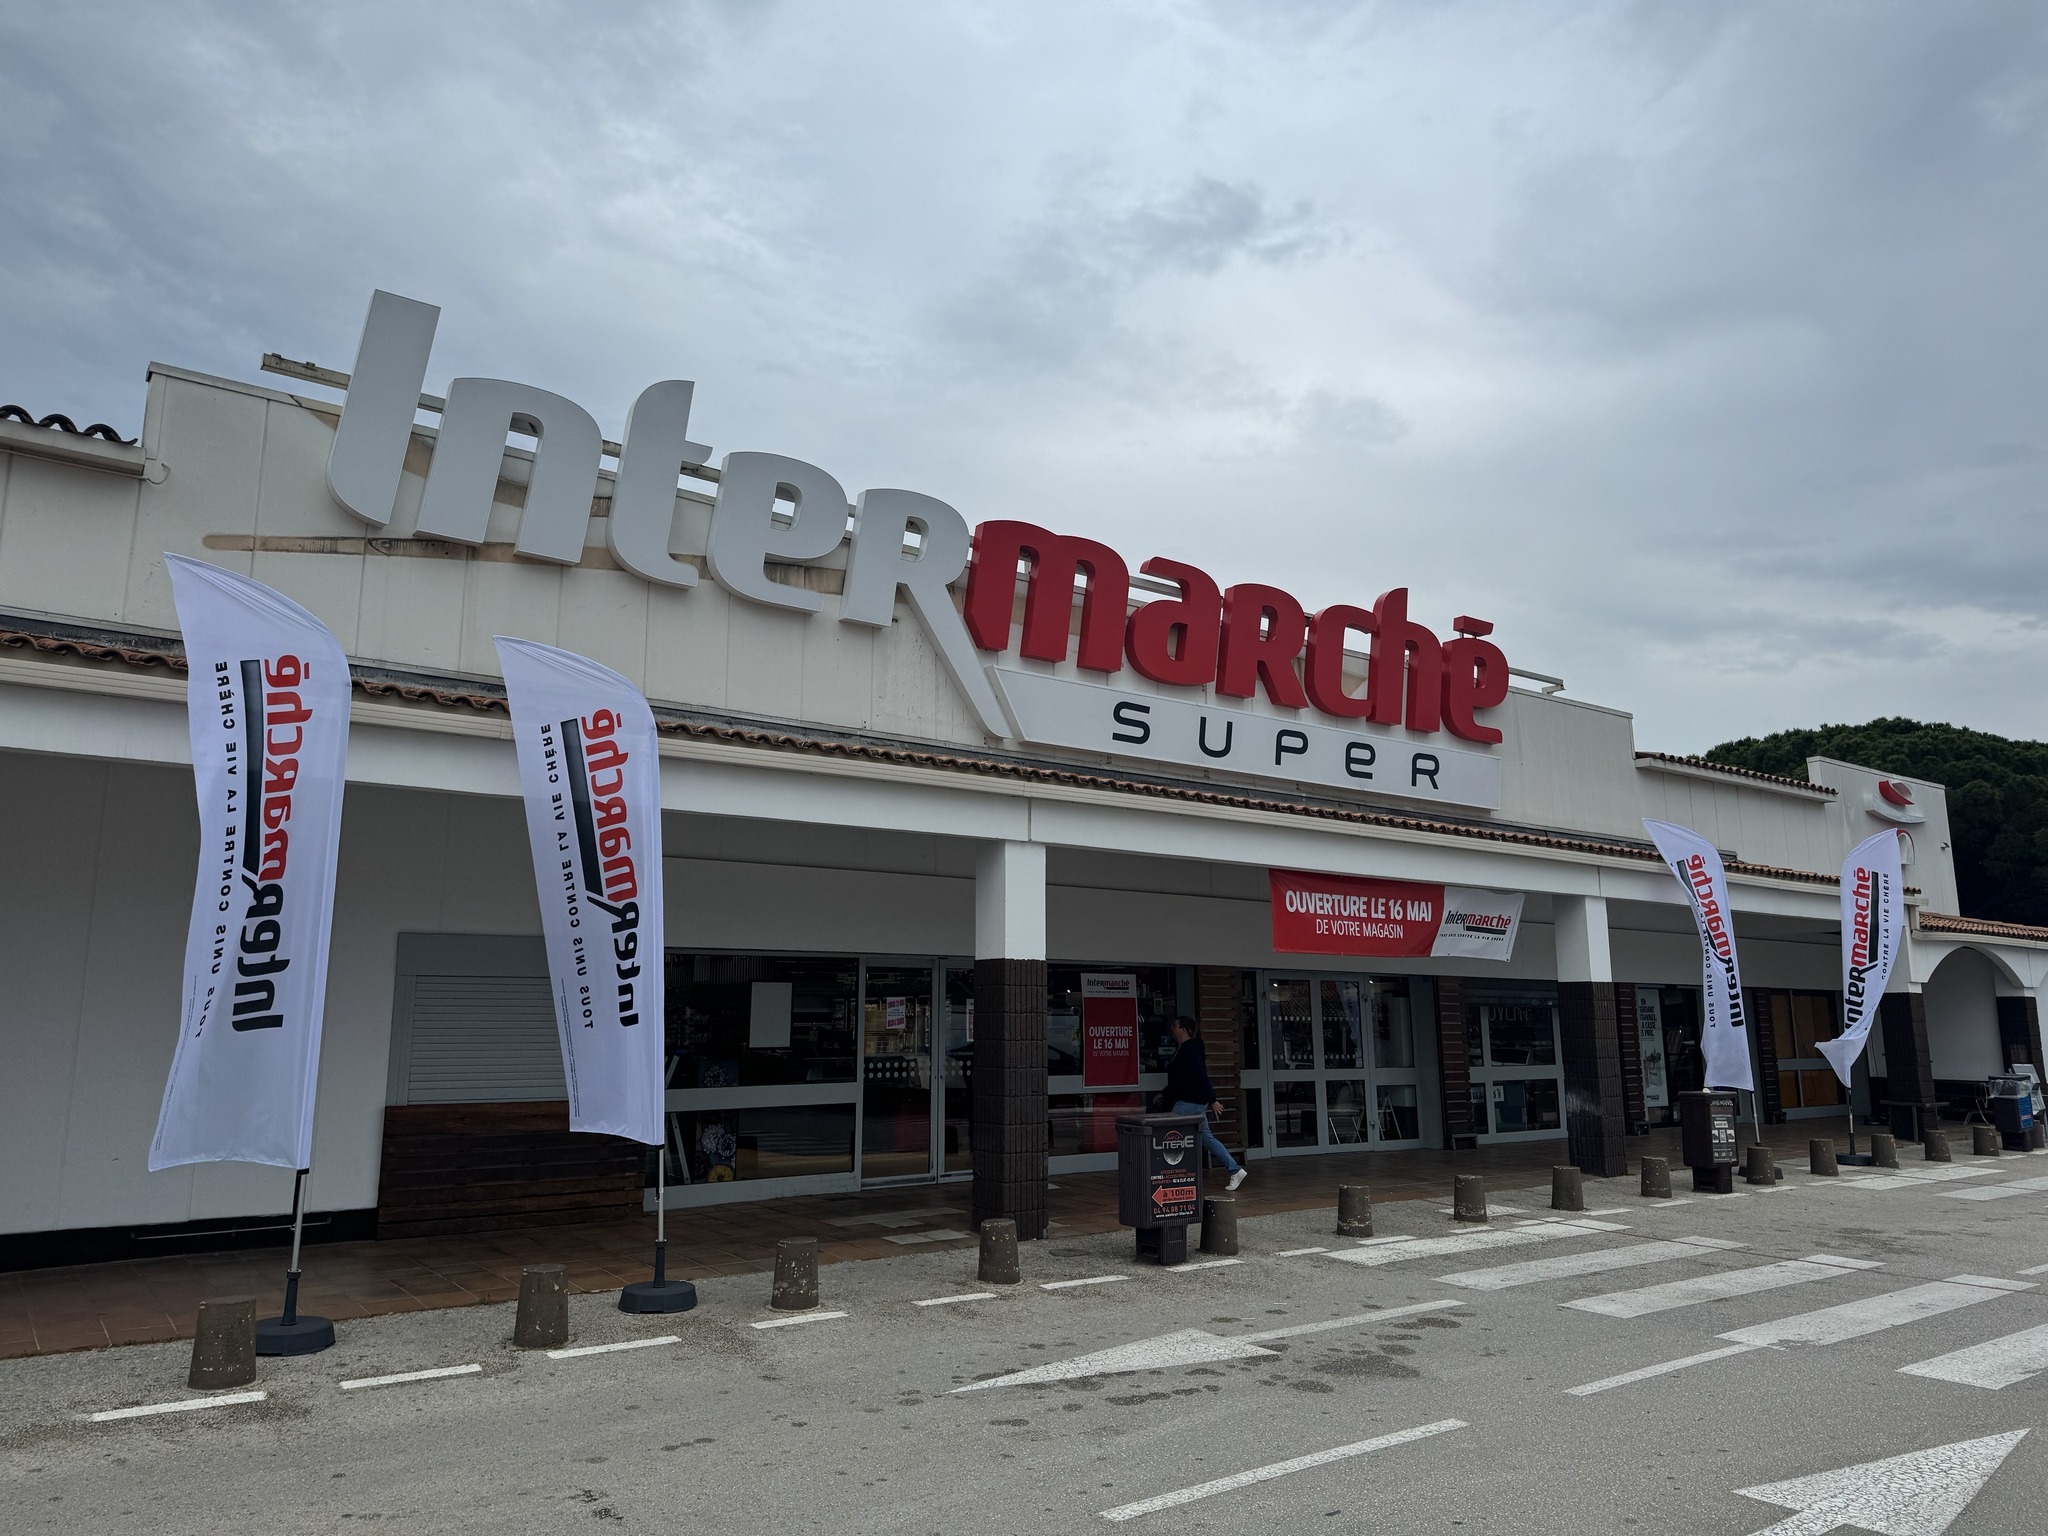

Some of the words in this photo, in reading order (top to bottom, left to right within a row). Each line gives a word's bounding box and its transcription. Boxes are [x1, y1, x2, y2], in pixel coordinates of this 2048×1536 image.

[1110, 701, 1441, 791] SUPER
[1285, 890, 1368, 918] OUVERTURE
[1371, 897, 1385, 919] LE
[1388, 899, 1404, 921] 16
[1407, 900, 1432, 922] MAI
[1316, 919, 1329, 935] DE
[1330, 920, 1360, 937] VOTRE
[1363, 921, 1404, 939] MAGASIN
[1882, 928, 1889, 939] LA
[1089, 1026, 1132, 1037] OUVERTURE
[1093, 1038, 1103, 1049] LE
[1104, 1038, 1113, 1049] 16
[1114, 1039, 1129, 1049] MAI
